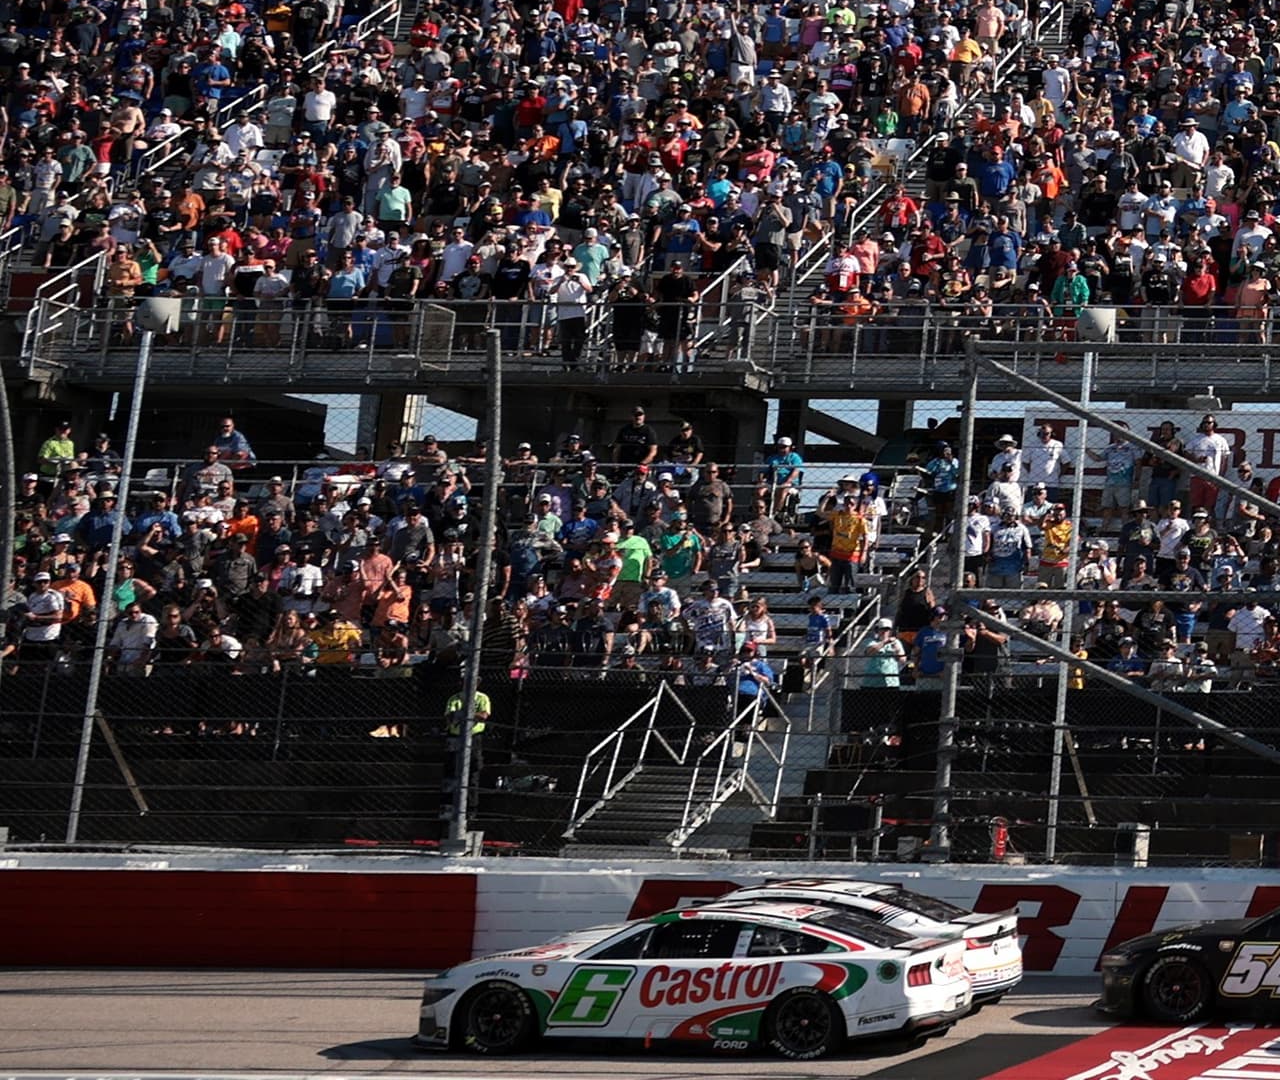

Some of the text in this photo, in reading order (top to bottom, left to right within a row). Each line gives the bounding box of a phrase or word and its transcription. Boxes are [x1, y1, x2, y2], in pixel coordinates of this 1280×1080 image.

[550, 966, 632, 1025] 6
[638, 961, 782, 1008] Castrol
[713, 1039, 749, 1050] FORD
